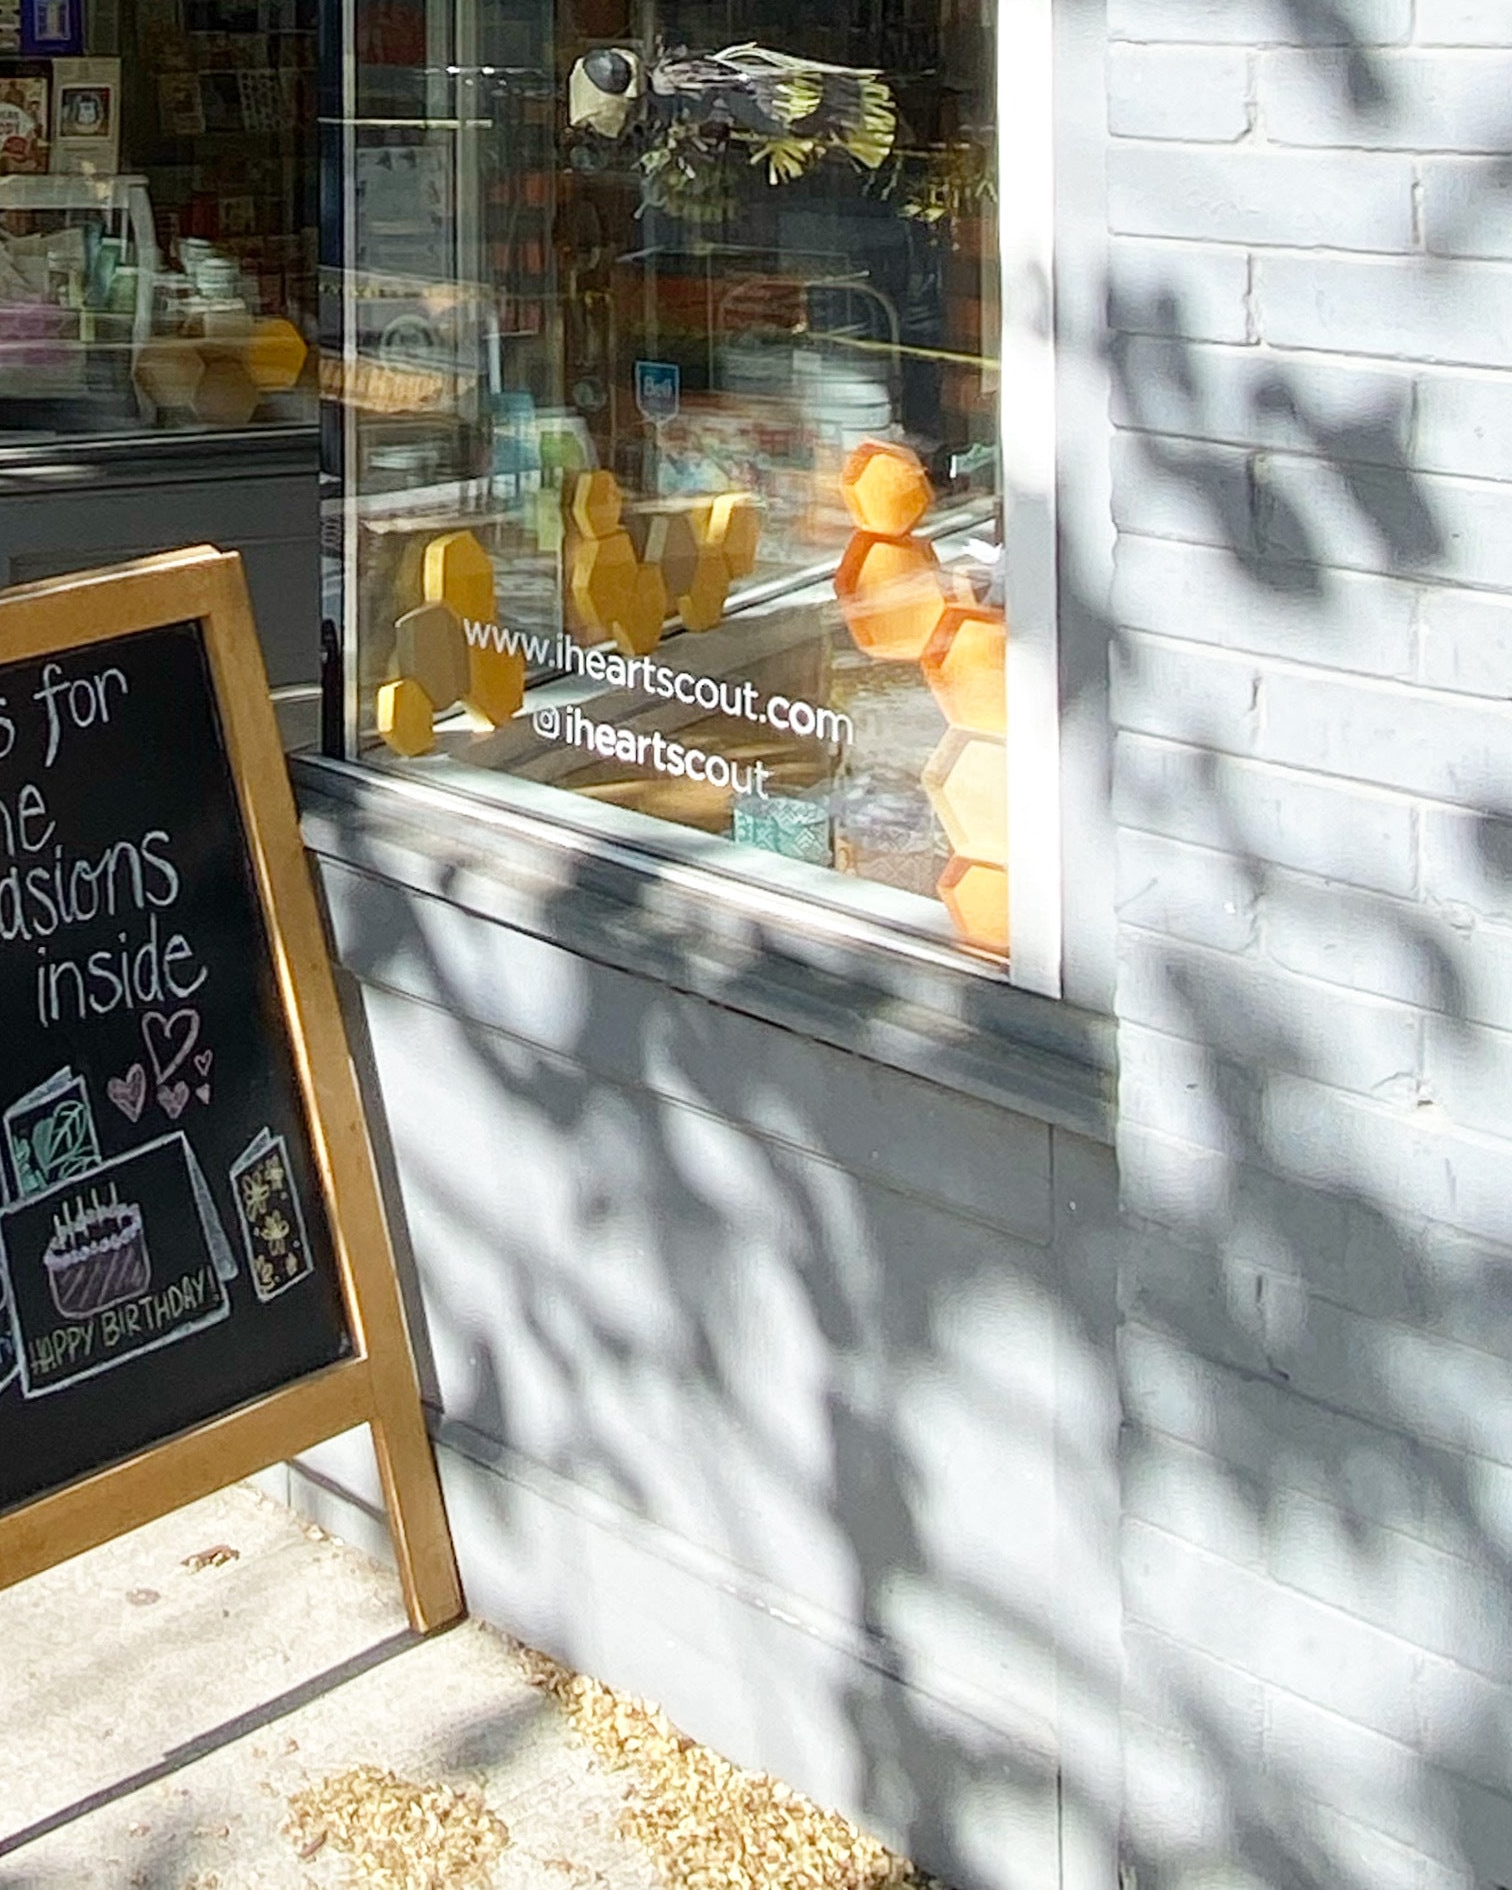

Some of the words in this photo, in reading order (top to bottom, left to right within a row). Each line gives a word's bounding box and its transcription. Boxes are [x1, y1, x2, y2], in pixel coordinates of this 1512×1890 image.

[32, 663, 128, 767] for
[462, 617, 854, 745] www.iheartscout.com
[36, 913, 207, 1027] inside
[27, 1320, 96, 1376] HAPPY
[100, 1264, 221, 1349] BIRTHDAY!
